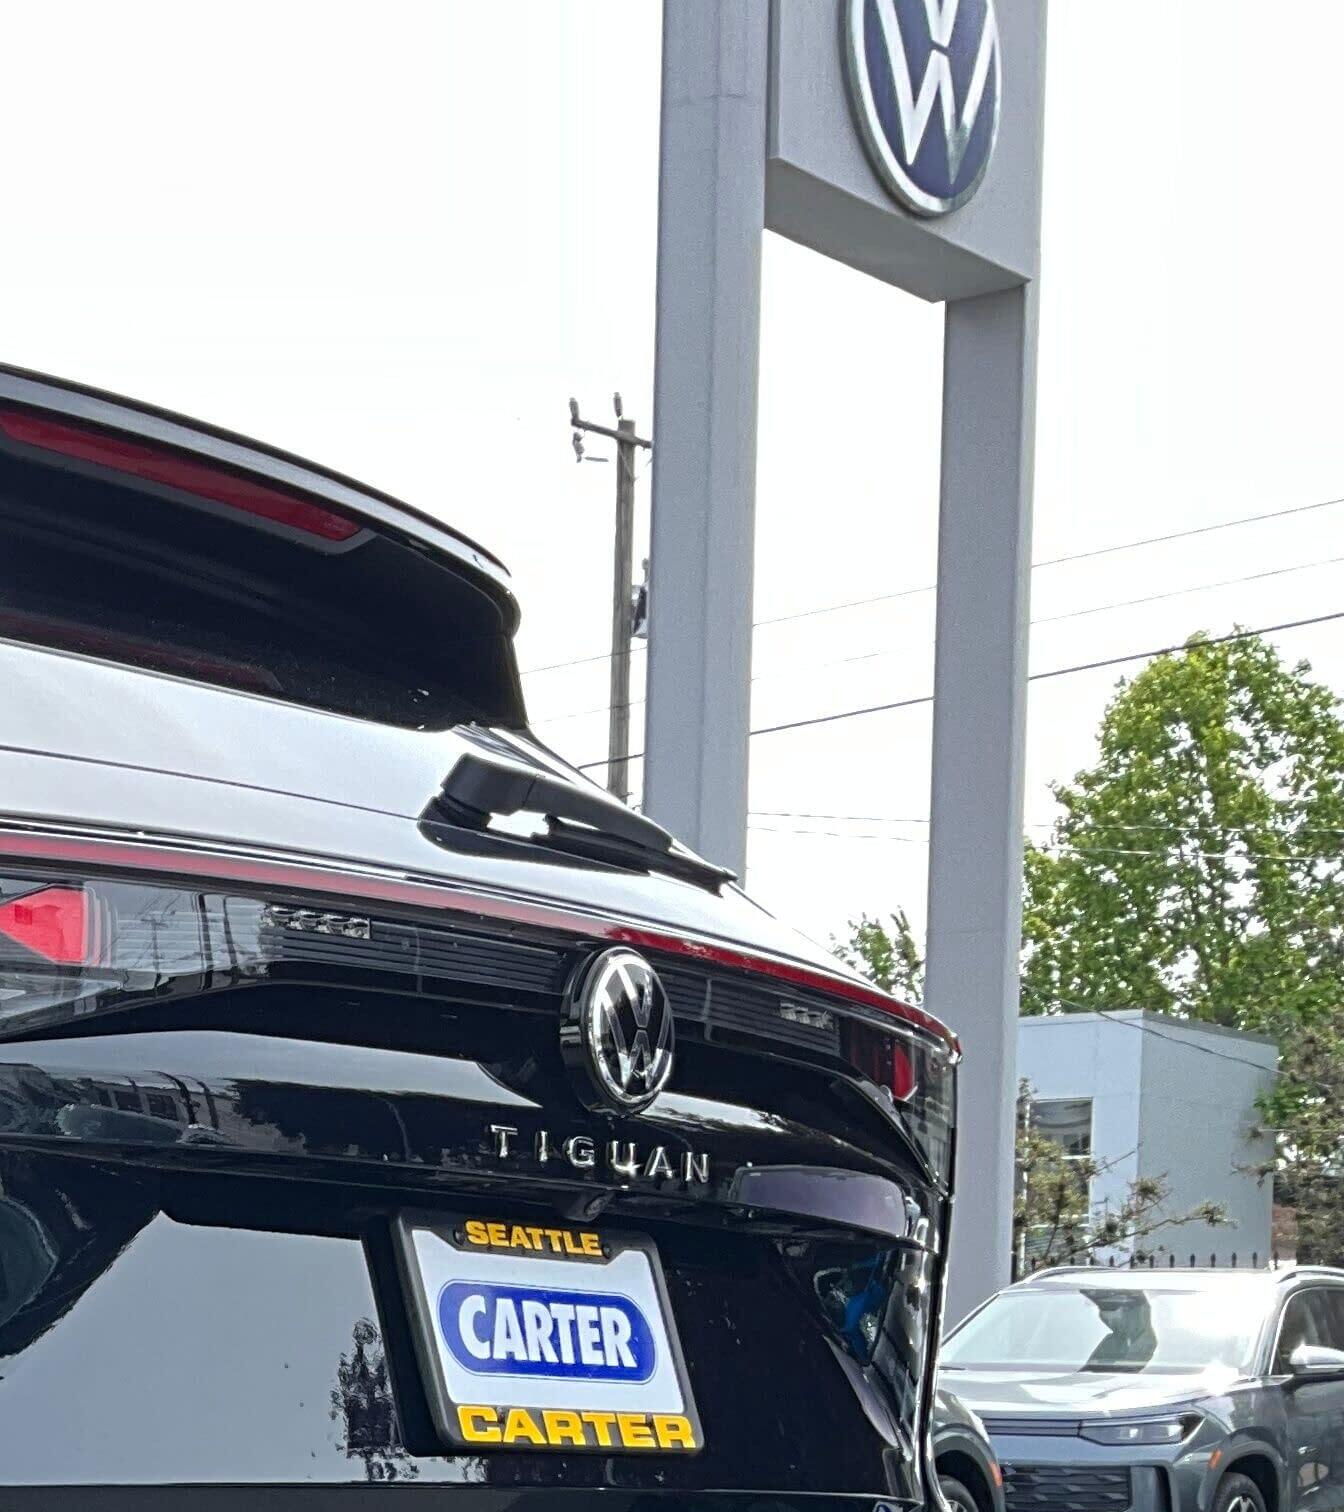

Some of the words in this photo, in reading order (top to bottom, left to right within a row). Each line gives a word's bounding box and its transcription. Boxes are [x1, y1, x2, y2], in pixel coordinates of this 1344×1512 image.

[490, 1124, 711, 1184] TIGUAN
[465, 1221, 603, 1257] SEATTLE
[458, 1293, 638, 1369] CARTER
[457, 1406, 696, 1450] CARTER
